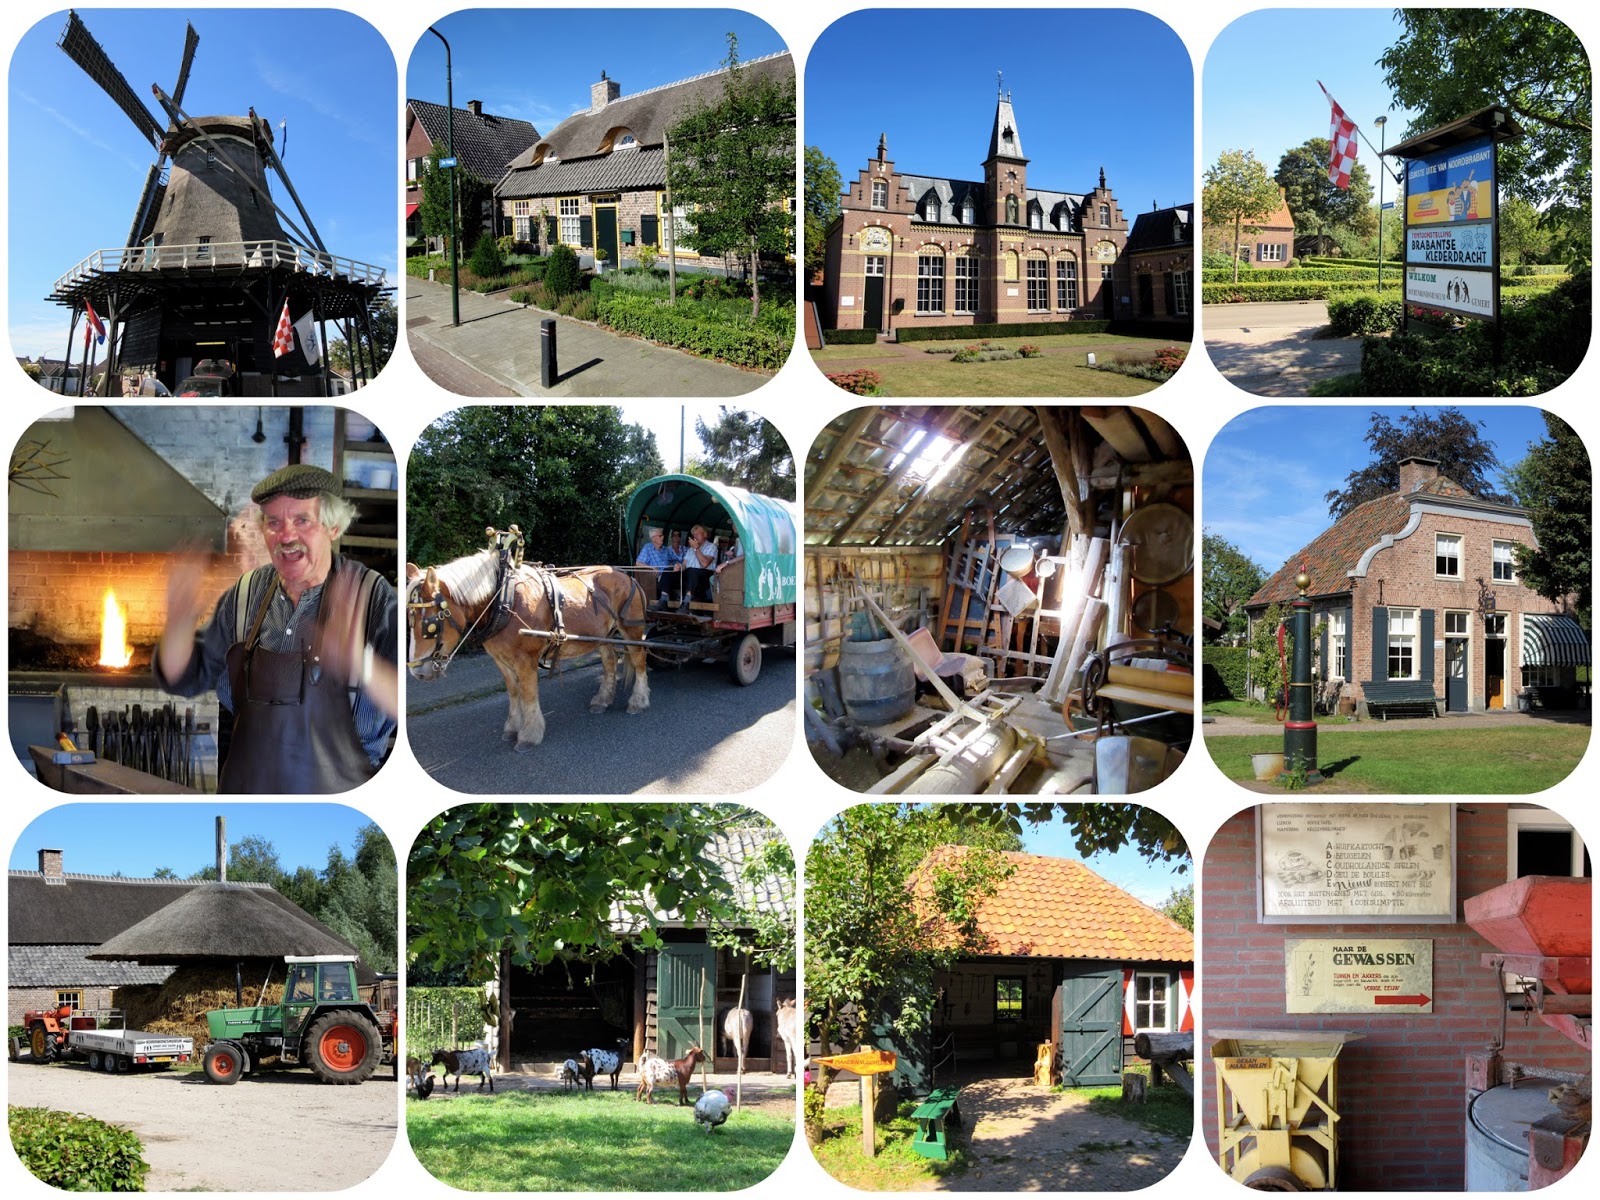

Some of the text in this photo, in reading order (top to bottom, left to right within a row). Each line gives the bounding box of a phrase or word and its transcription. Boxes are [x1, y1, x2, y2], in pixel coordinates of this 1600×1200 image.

[1411, 231, 1452, 239] TENTOONSTELLING
[1411, 239, 1456, 251] BRABANTSE
[1425, 250, 1487, 264] KLEDERDRACHT
[1408, 272, 1437, 283] WELKOM
[1393, 862, 1420, 870] SPELEN
[1401, 880, 1417, 888] MET
[1419, 881, 1433, 889] BUS
[1353, 889, 1368, 897] MET
[1327, 899, 1344, 907] MET
[1332, 953, 1416, 966] GEWASSEN
